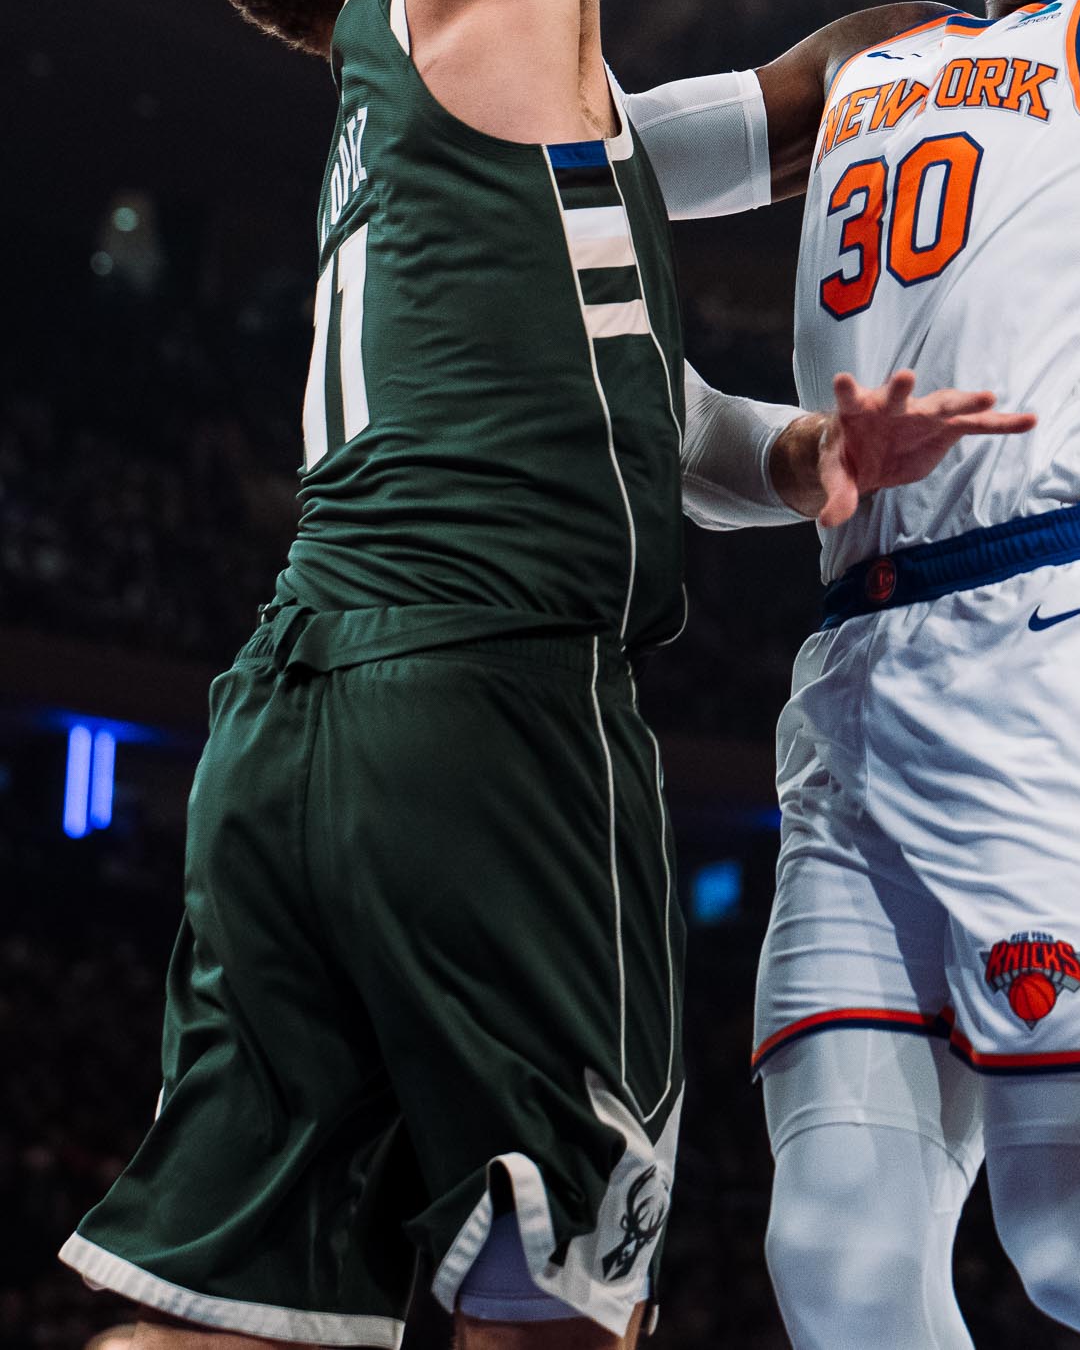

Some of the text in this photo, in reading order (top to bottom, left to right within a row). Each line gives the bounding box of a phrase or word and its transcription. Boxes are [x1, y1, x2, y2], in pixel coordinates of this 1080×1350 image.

[817, 56, 1059, 166] NEW ORK
[819, 130, 985, 322] 30
[302, 222, 371, 472] 11
